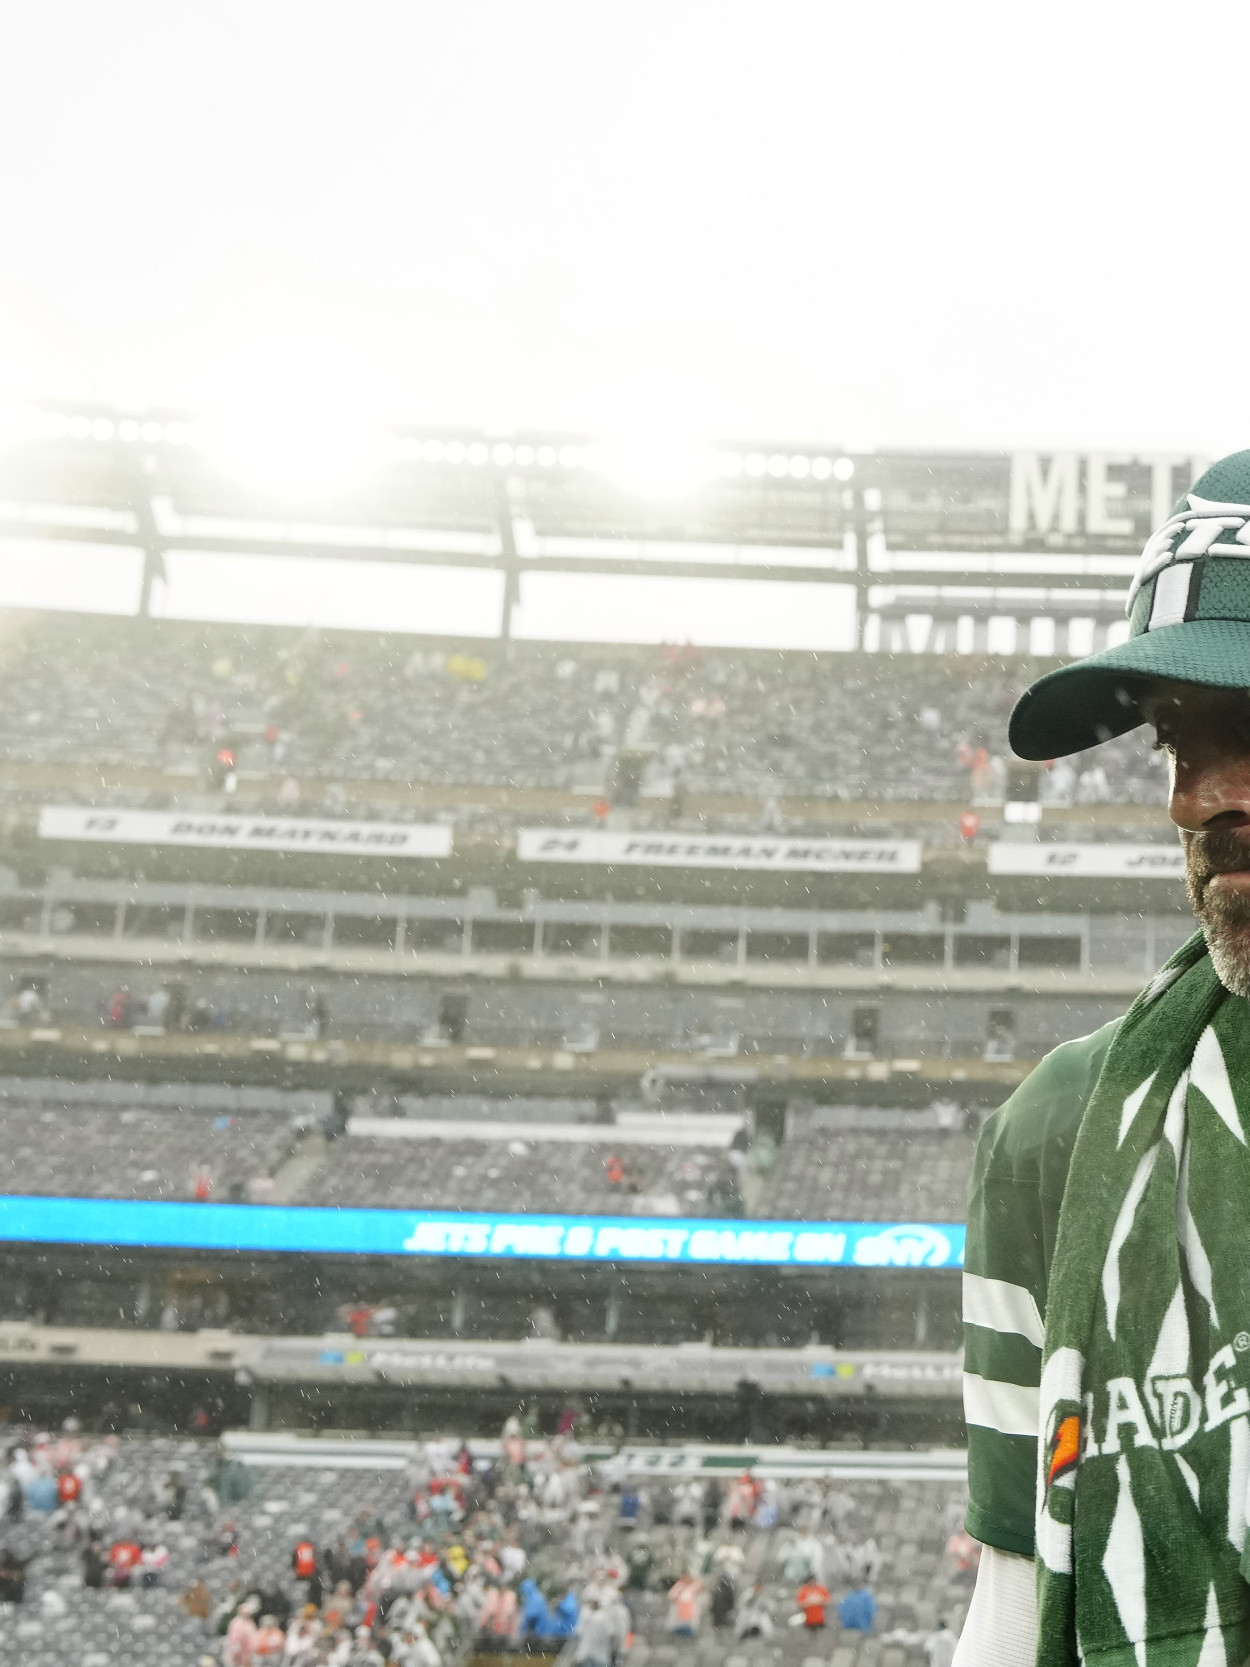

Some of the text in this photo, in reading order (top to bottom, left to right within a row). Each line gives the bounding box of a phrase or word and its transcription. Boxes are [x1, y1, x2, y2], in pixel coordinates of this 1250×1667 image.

[170, 821, 240, 837] DON
[247, 825, 410, 846] MAYNARD
[623, 841, 776, 860] FREEMAN
[403, 1222, 492, 1252] JETS
[593, 1227, 689, 1259] POST
